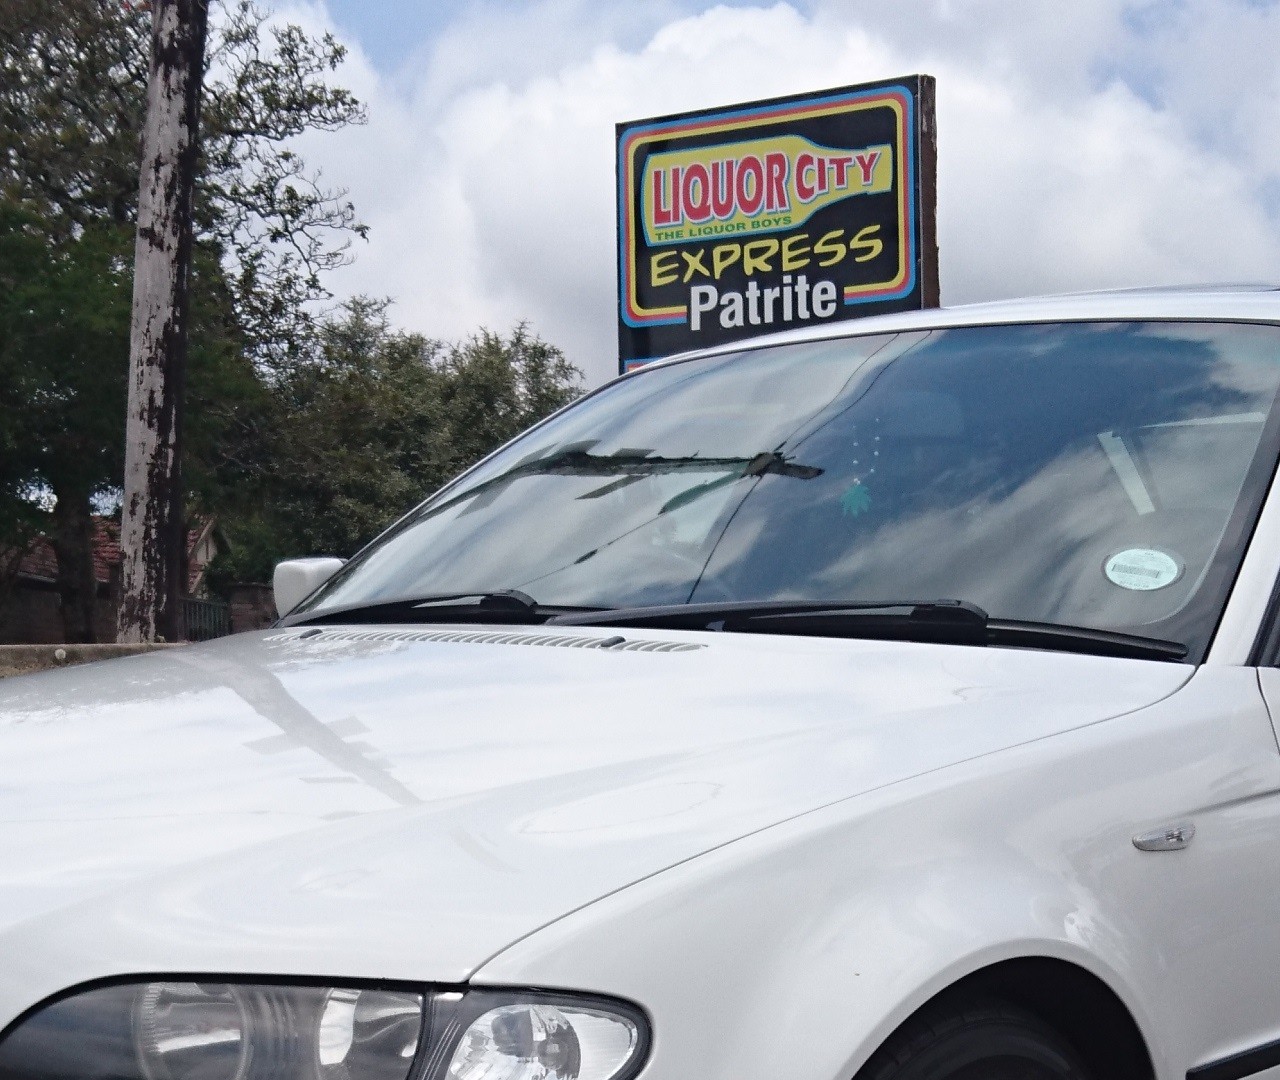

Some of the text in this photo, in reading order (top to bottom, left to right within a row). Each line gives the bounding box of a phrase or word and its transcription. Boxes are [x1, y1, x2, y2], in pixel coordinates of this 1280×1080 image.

[651, 150, 881, 227] LIQUOR CITY
[651, 224, 883, 287] EXPRESS
[655, 216, 792, 241] THE LIQUOR BOYS
[690, 275, 837, 331] Patrite
